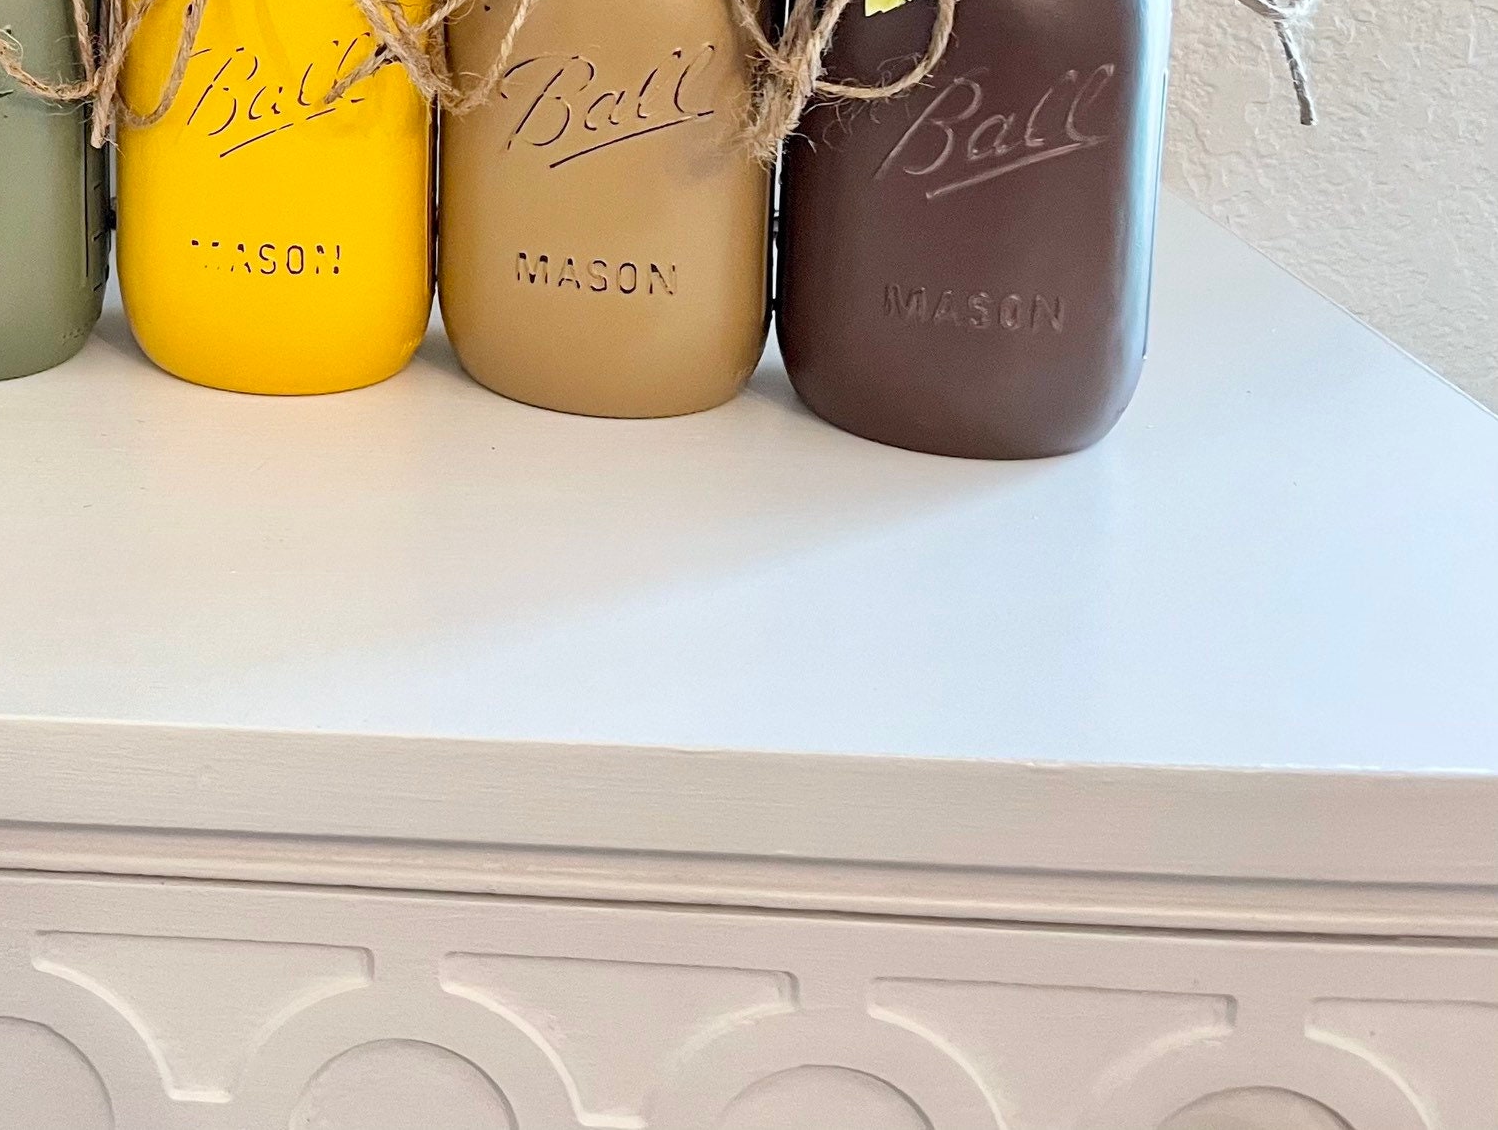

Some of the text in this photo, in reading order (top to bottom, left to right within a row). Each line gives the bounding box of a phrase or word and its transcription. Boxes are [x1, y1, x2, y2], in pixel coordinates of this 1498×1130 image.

[501, 43, 715, 168] Ball
[873, 63, 1115, 200] Ball
[191, 239, 340, 275] ASON
[517, 251, 678, 295] MASON
[883, 284, 1065, 335] MASON
